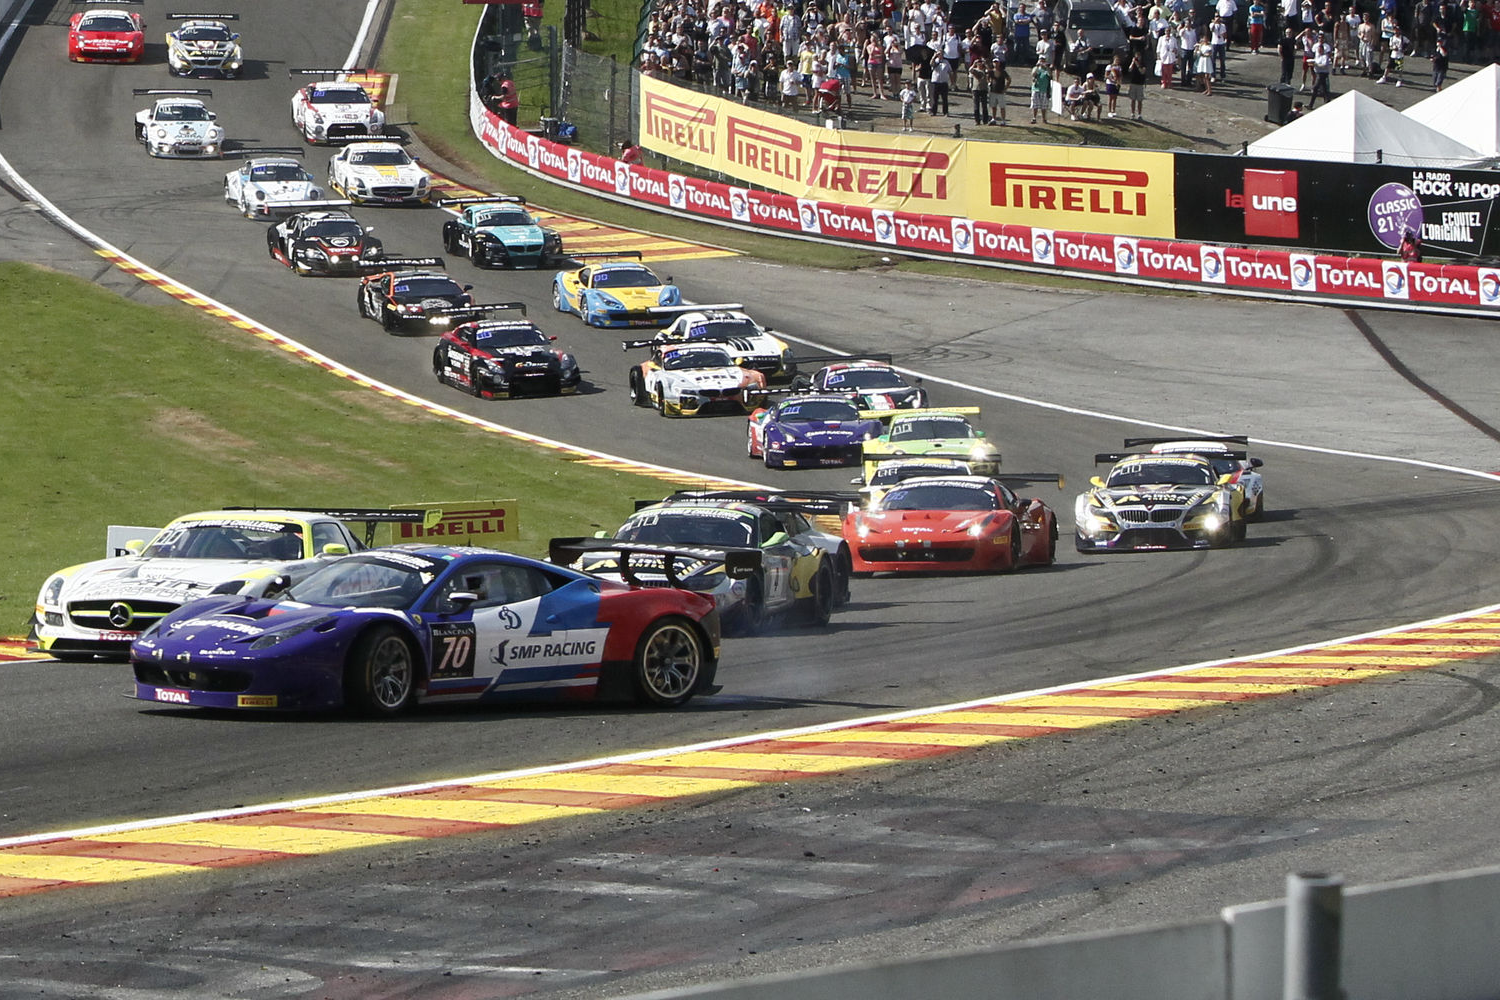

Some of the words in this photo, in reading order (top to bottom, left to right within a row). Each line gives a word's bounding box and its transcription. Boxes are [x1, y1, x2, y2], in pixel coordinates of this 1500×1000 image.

[645, 91, 716, 155] PIRELLI
[506, 129, 528, 161] TOTAL
[538, 145, 567, 172] TOTAL
[727, 116, 802, 183] PIRELLI
[581, 158, 615, 185] TOTAL
[806, 141, 950, 200] PIRELLI
[1413, 171, 1424, 180] LA
[1425, 172, 1451, 182] RADIO
[630, 171, 669, 198] TOTAL
[686, 185, 730, 211] TOTAL
[990, 162, 1149, 217] PIRELLI
[1413, 180, 1452, 197] ROCK
[1471, 183, 1500, 201] POP
[749, 199, 799, 224] TOTAL
[1225, 188, 1245, 209] la
[1252, 194, 1297, 213] une
[1375, 197, 1418, 217] CLASSIC
[819, 208, 873, 234] TOTAL
[895, 218, 951, 245] TOTAL
[1378, 216, 1395, 233] 21
[1442, 211, 1482, 228] ECOUTEZ
[975, 227, 1030, 254] TOTAL
[1055, 237, 1113, 264] TOTAL
[1139, 246, 1199, 273] TOTAL
[1227, 256, 1289, 281] TOTAL
[1317, 263, 1381, 290] TOTAL
[1410, 270, 1477, 297] TOTAL
[401, 509, 505, 538] PIRELLI
[219, 620, 265, 635] RACING
[433, 627, 474, 637] BLANCPAIN
[438, 637, 471, 669] 70
[510, 643, 541, 660] SMP
[543, 641, 596, 658] RACING
[155, 689, 190, 704] TOTAL
